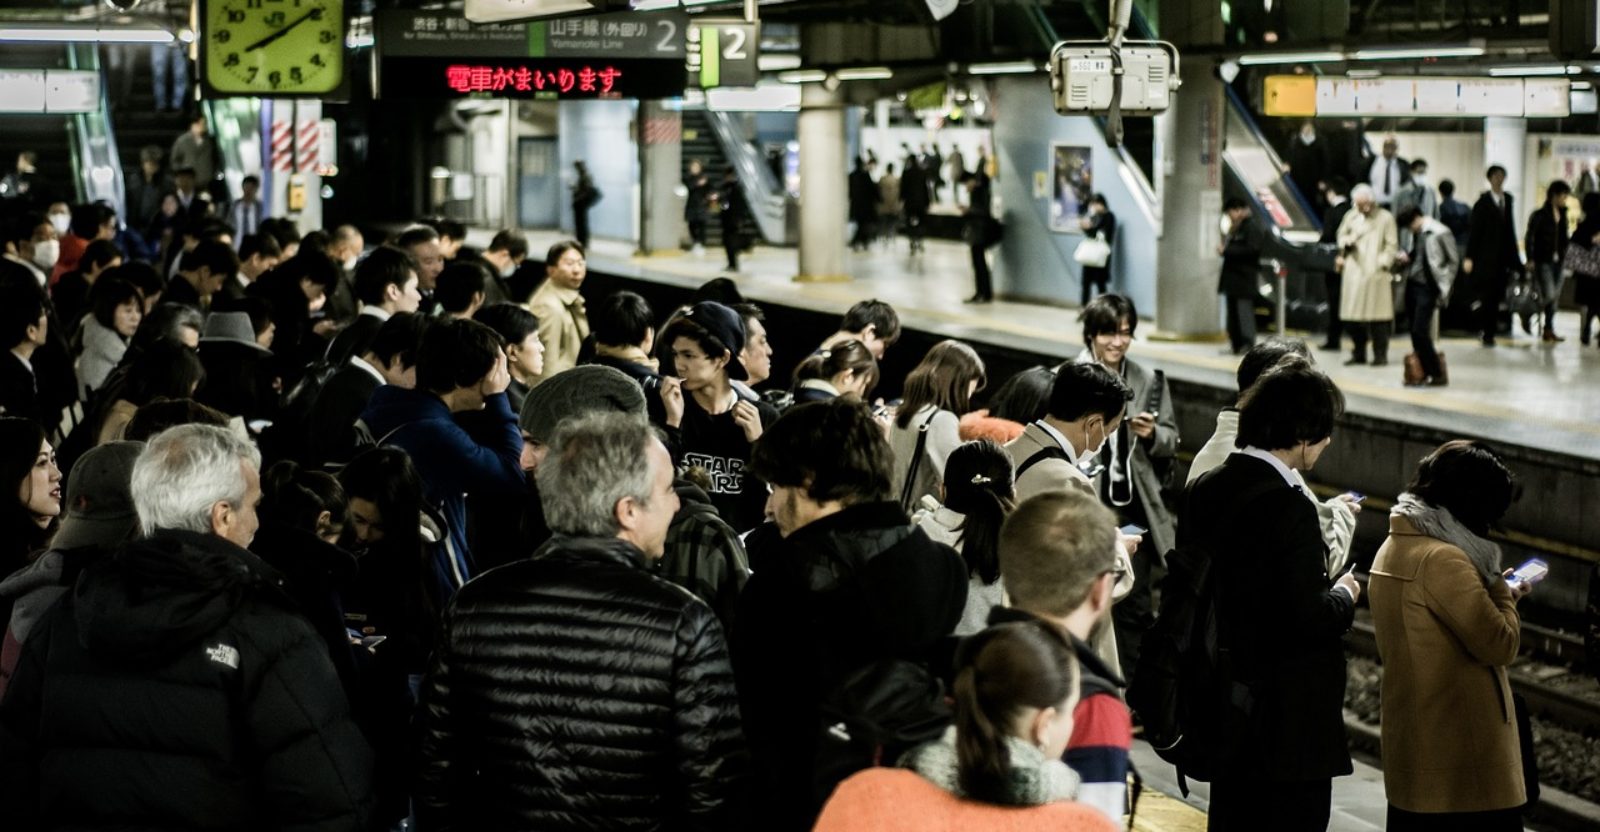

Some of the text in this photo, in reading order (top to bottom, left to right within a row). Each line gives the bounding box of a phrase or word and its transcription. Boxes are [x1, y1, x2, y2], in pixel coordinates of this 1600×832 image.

[228, 9, 246, 23] 10
[217, 29, 231, 43] 9
[319, 30, 332, 44] 3
[656, 20, 678, 52] 2
[551, 39, 624, 49] Yamanote Line
[723, 28, 747, 60] 2
[227, 52, 241, 66] 8
[310, 53, 321, 66] 4
[247, 66, 259, 82] 7
[268, 71, 281, 85] 6
[289, 66, 302, 81] 5
[446, 65, 622, 93] 電車がまいります
[681, 452, 745, 477] STAR
